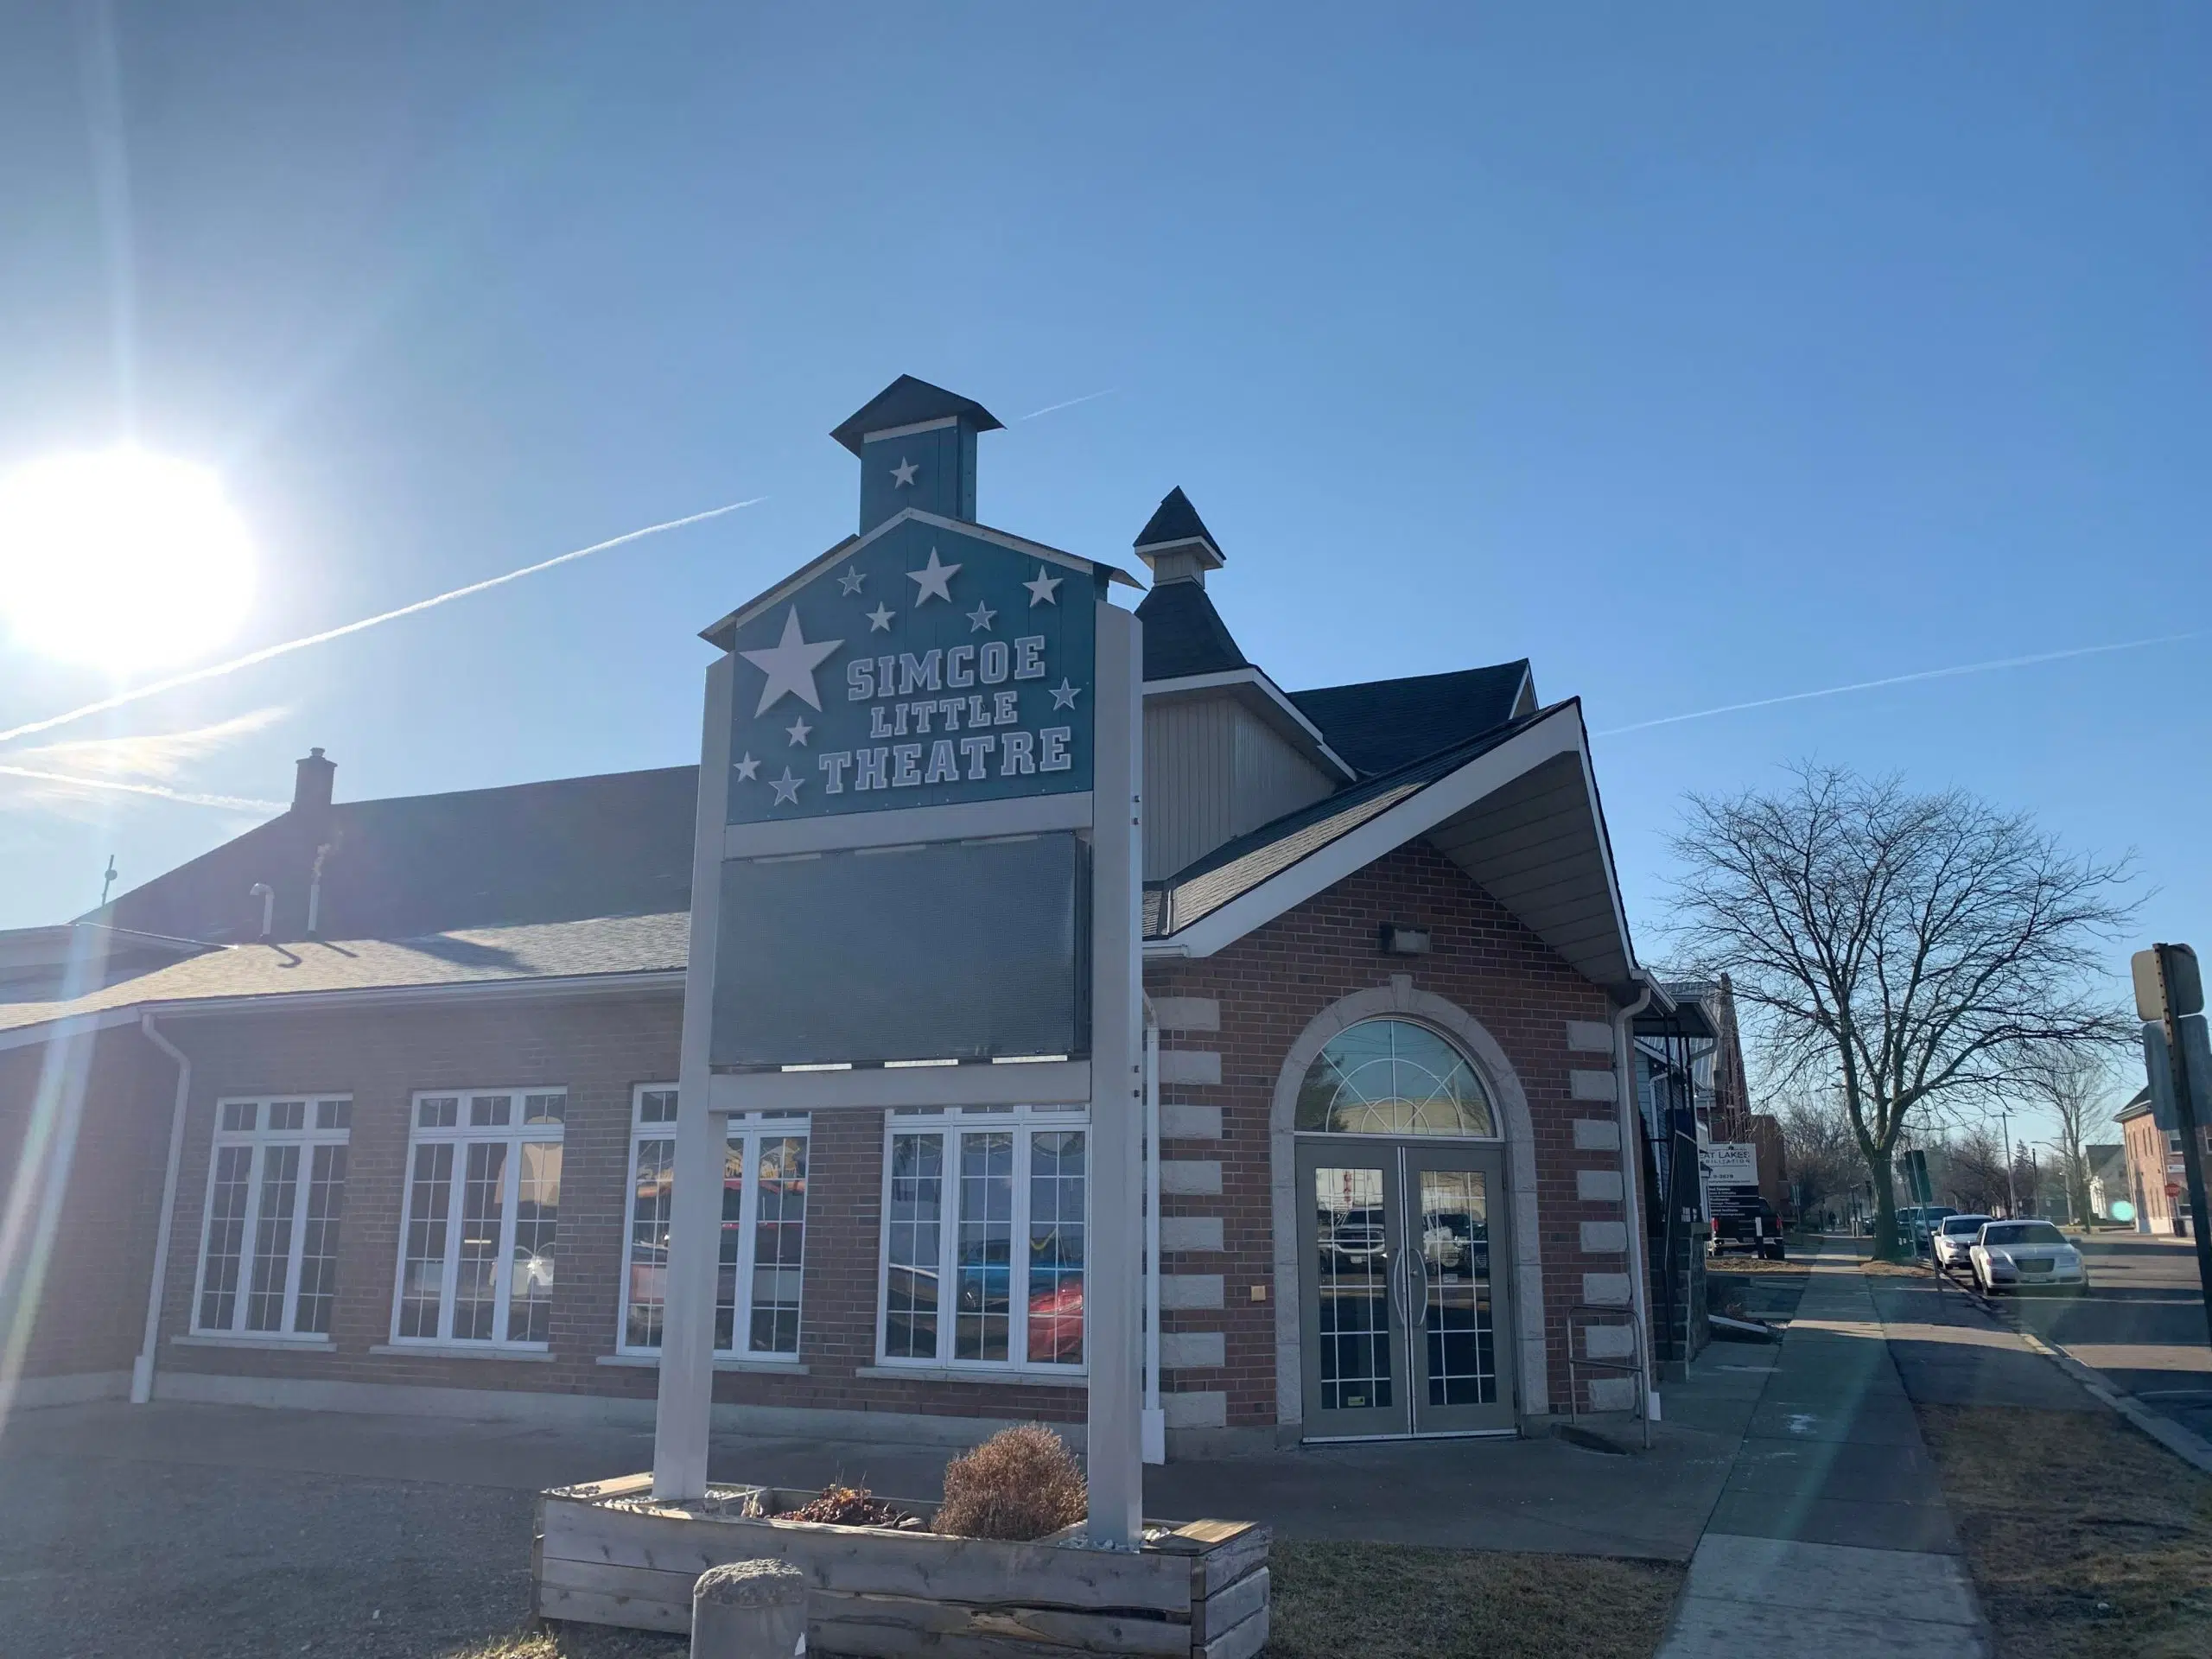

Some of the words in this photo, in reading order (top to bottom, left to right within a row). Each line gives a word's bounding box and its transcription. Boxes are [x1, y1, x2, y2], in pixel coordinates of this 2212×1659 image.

[847, 634, 1046, 701] SIMCOE
[869, 690, 1018, 738] LITTLE
[818, 726, 1071, 794] THEATRE
